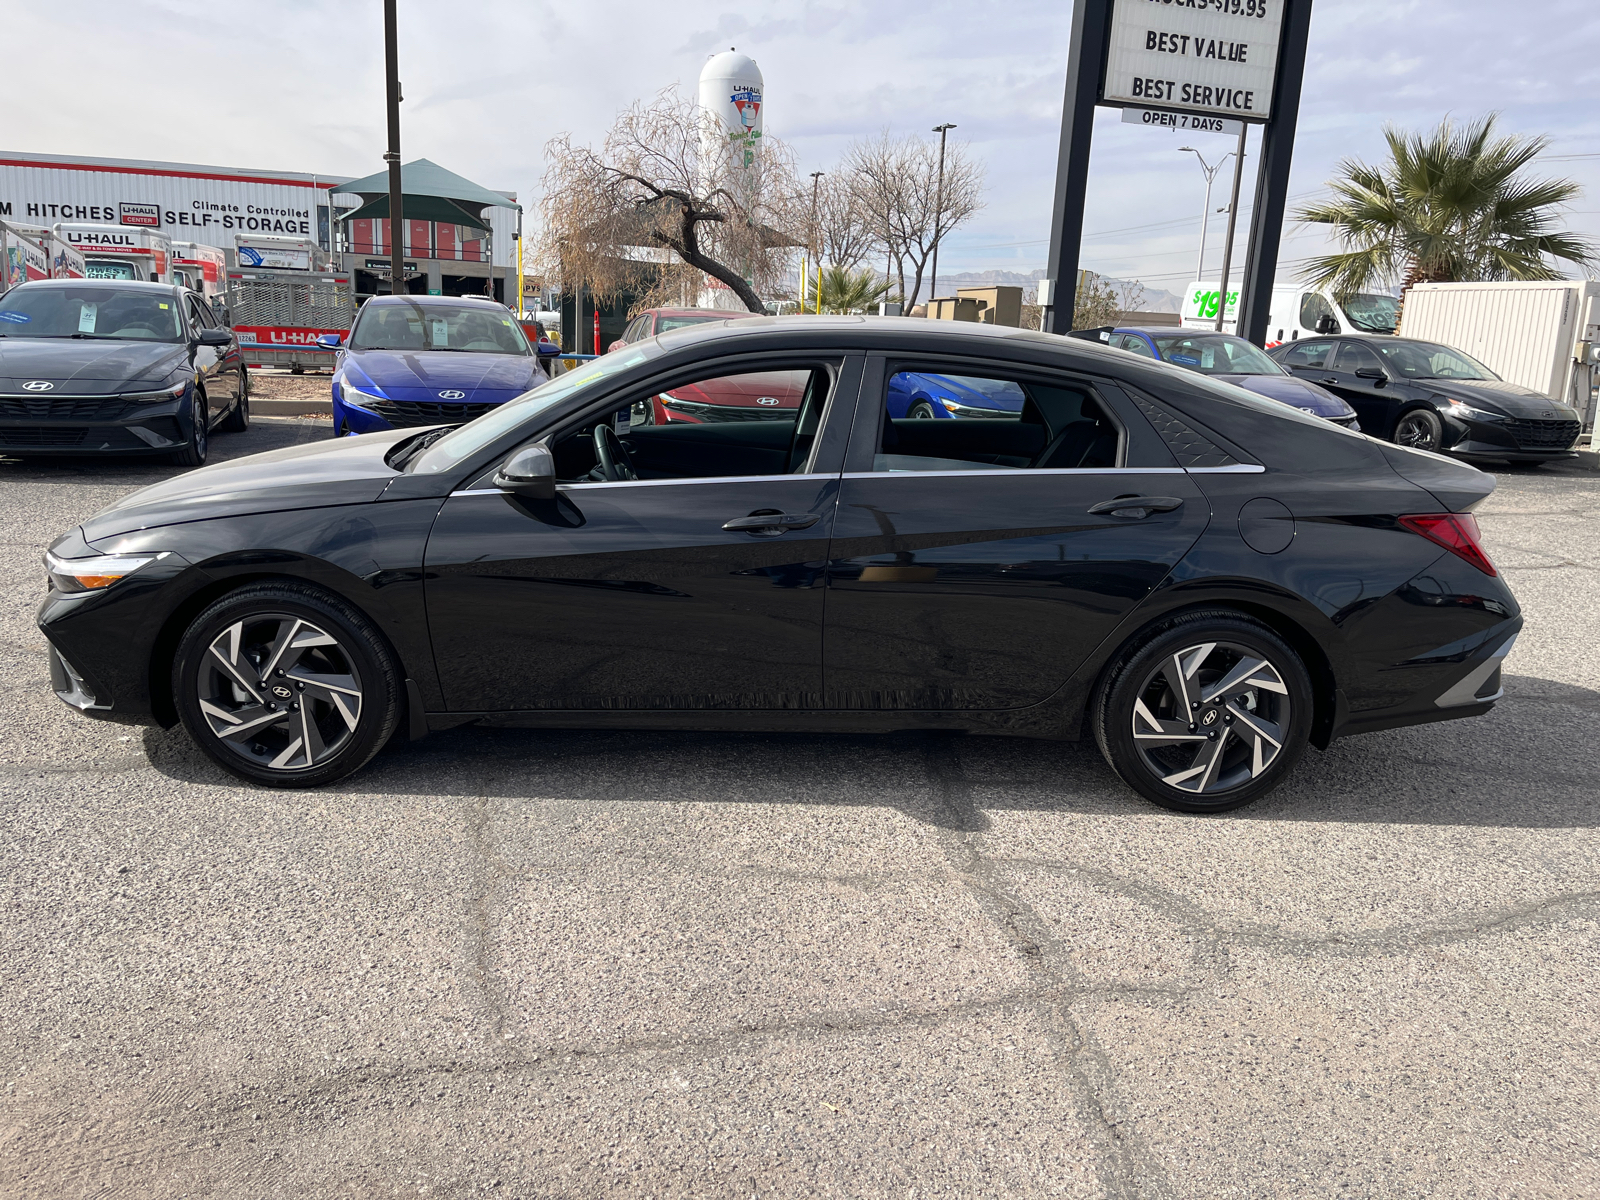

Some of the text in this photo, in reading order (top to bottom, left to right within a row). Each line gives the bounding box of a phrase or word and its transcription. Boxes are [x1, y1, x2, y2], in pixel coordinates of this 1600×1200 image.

[1149, 0, 1266, 18] S-$19.95
[1145, 30, 1248, 63] BEST VALUE
[1132, 77, 1254, 110] BEST SERVICE
[1142, 111, 1223, 131] OPEN 7 DAYS
[27, 203, 115, 220] HITCHES
[123, 206, 156, 215] U-HAUL
[192, 200, 309, 218] Climate Controlled
[126, 216, 153, 224] CENTER
[165, 211, 310, 234] SELF-STORAGE
[67, 232, 135, 246] U-HAUL
[86, 267, 128, 275] OWEST
[270, 331, 322, 343] U-HA
